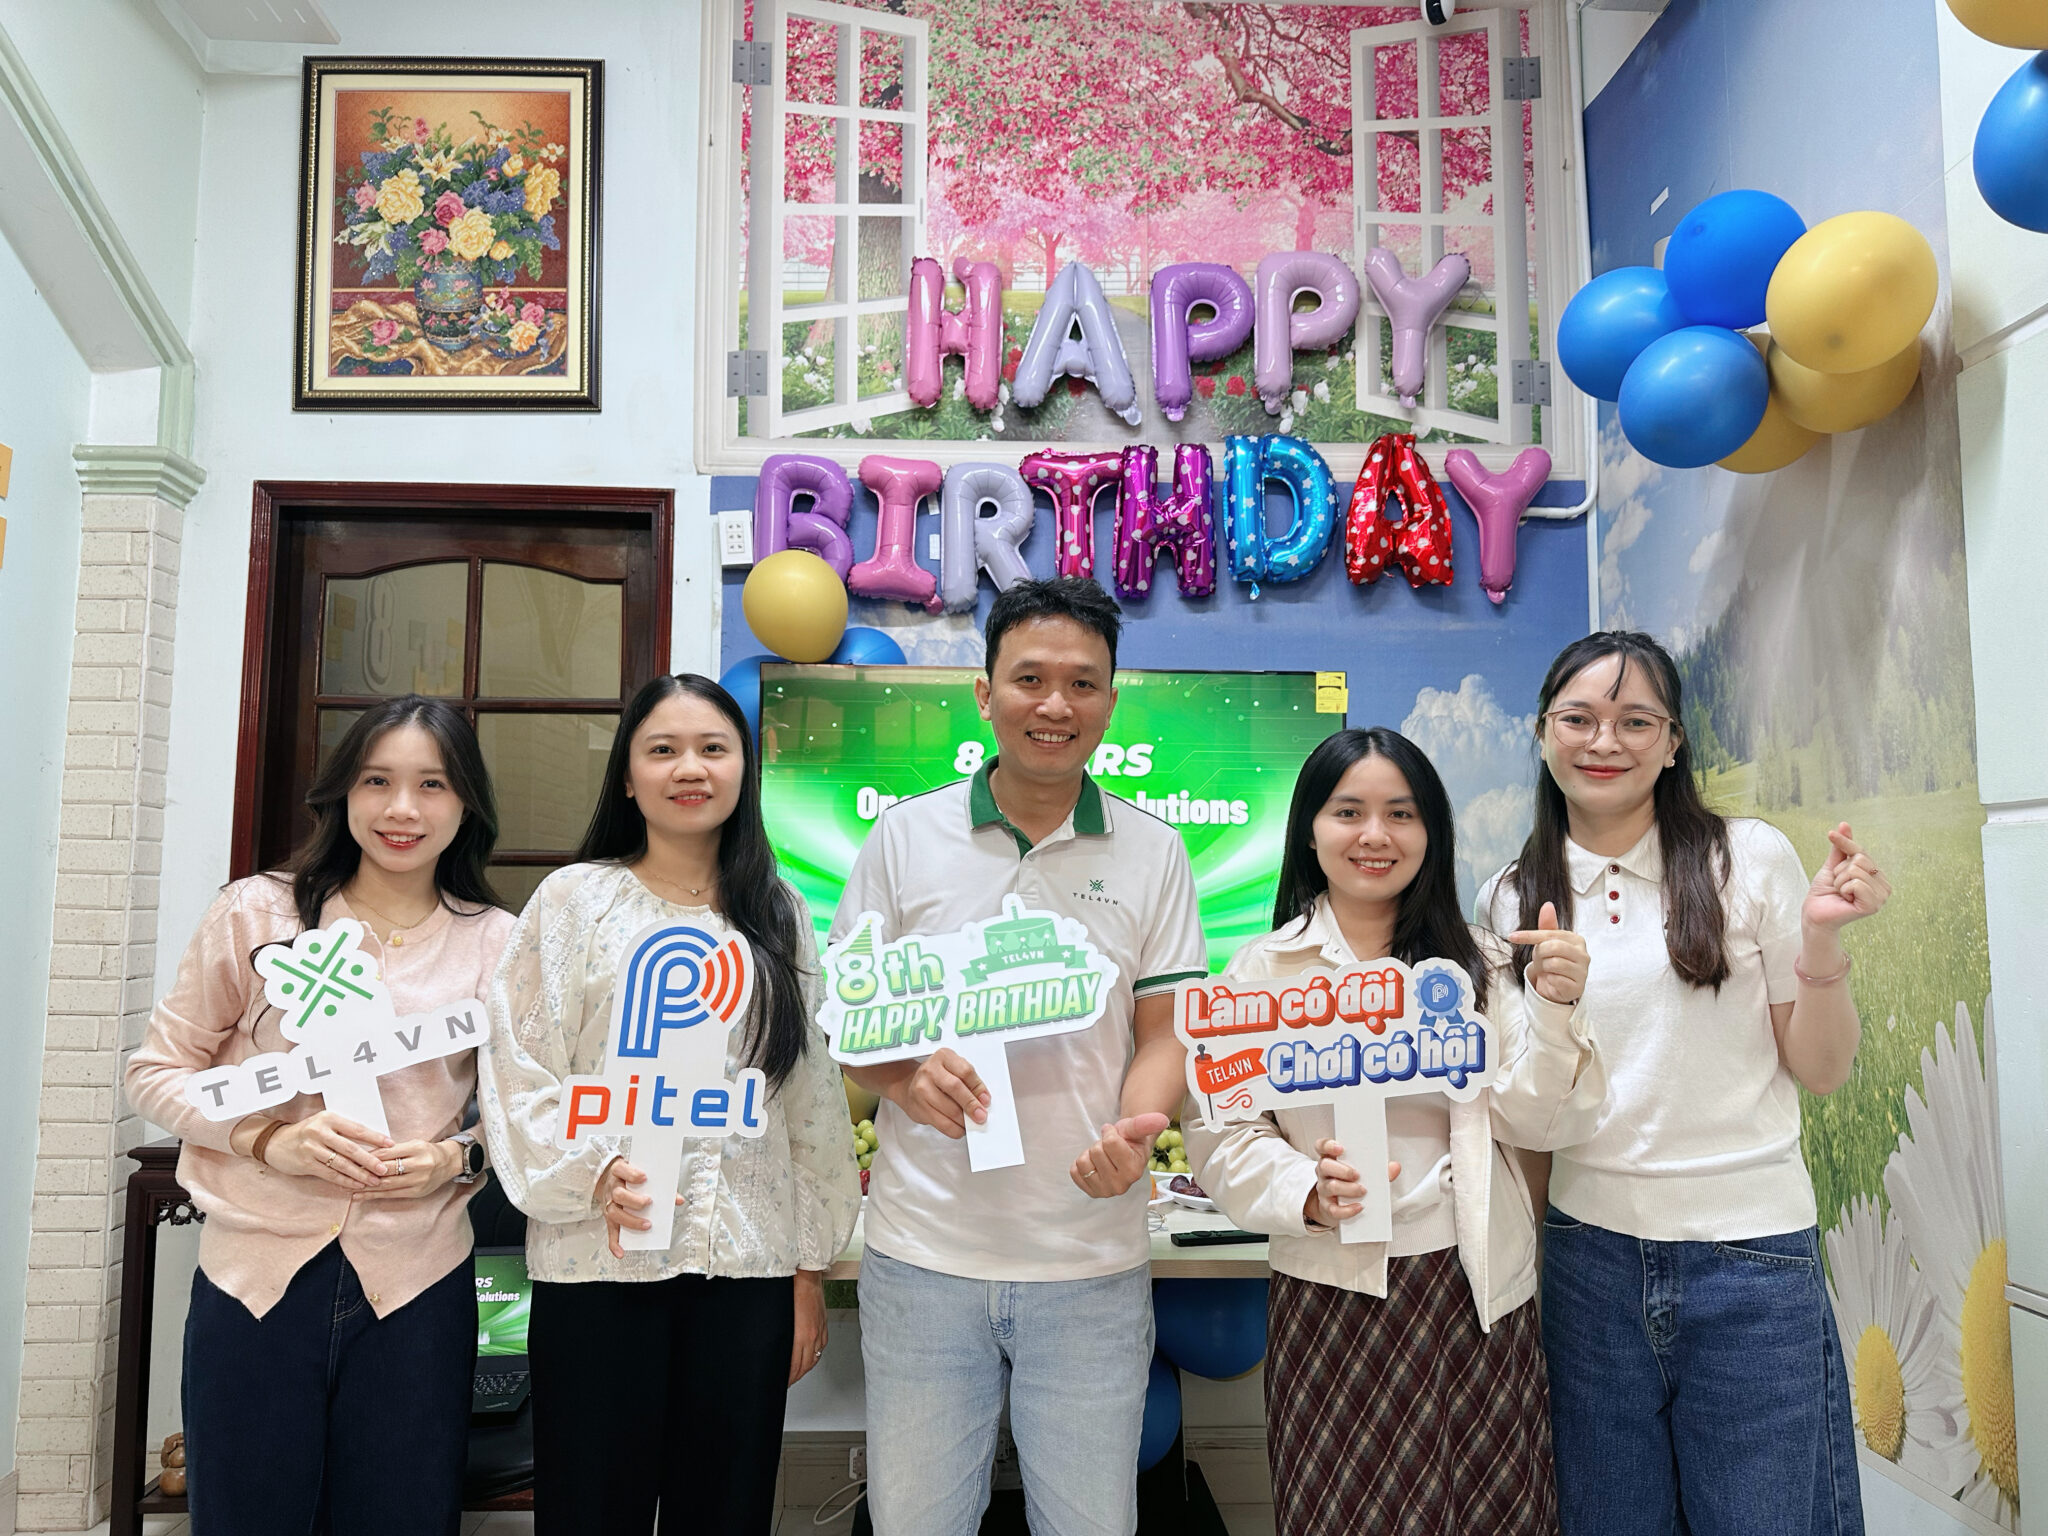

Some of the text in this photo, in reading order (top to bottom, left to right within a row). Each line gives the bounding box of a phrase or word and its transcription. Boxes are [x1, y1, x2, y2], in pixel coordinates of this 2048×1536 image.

[906, 246, 1472, 425] HAPPY
[753, 432, 1552, 613] BIRTHDAY
[953, 740, 1154, 777] 8 RS
[1071, 892, 1119, 906] TEL4VN
[835, 942, 945, 1005] 8th
[1000, 950, 1045, 965] TEL4VN
[839, 972, 1103, 1054] HAPPY BIRTHDAY
[1185, 967, 1405, 1038] Làm có đội
[202, 1011, 476, 1108] TEL4VN
[1205, 1057, 1254, 1086] TEL4VN
[1267, 1021, 1486, 1093] Chơi có hội
[565, 1074, 759, 1140] pitel
